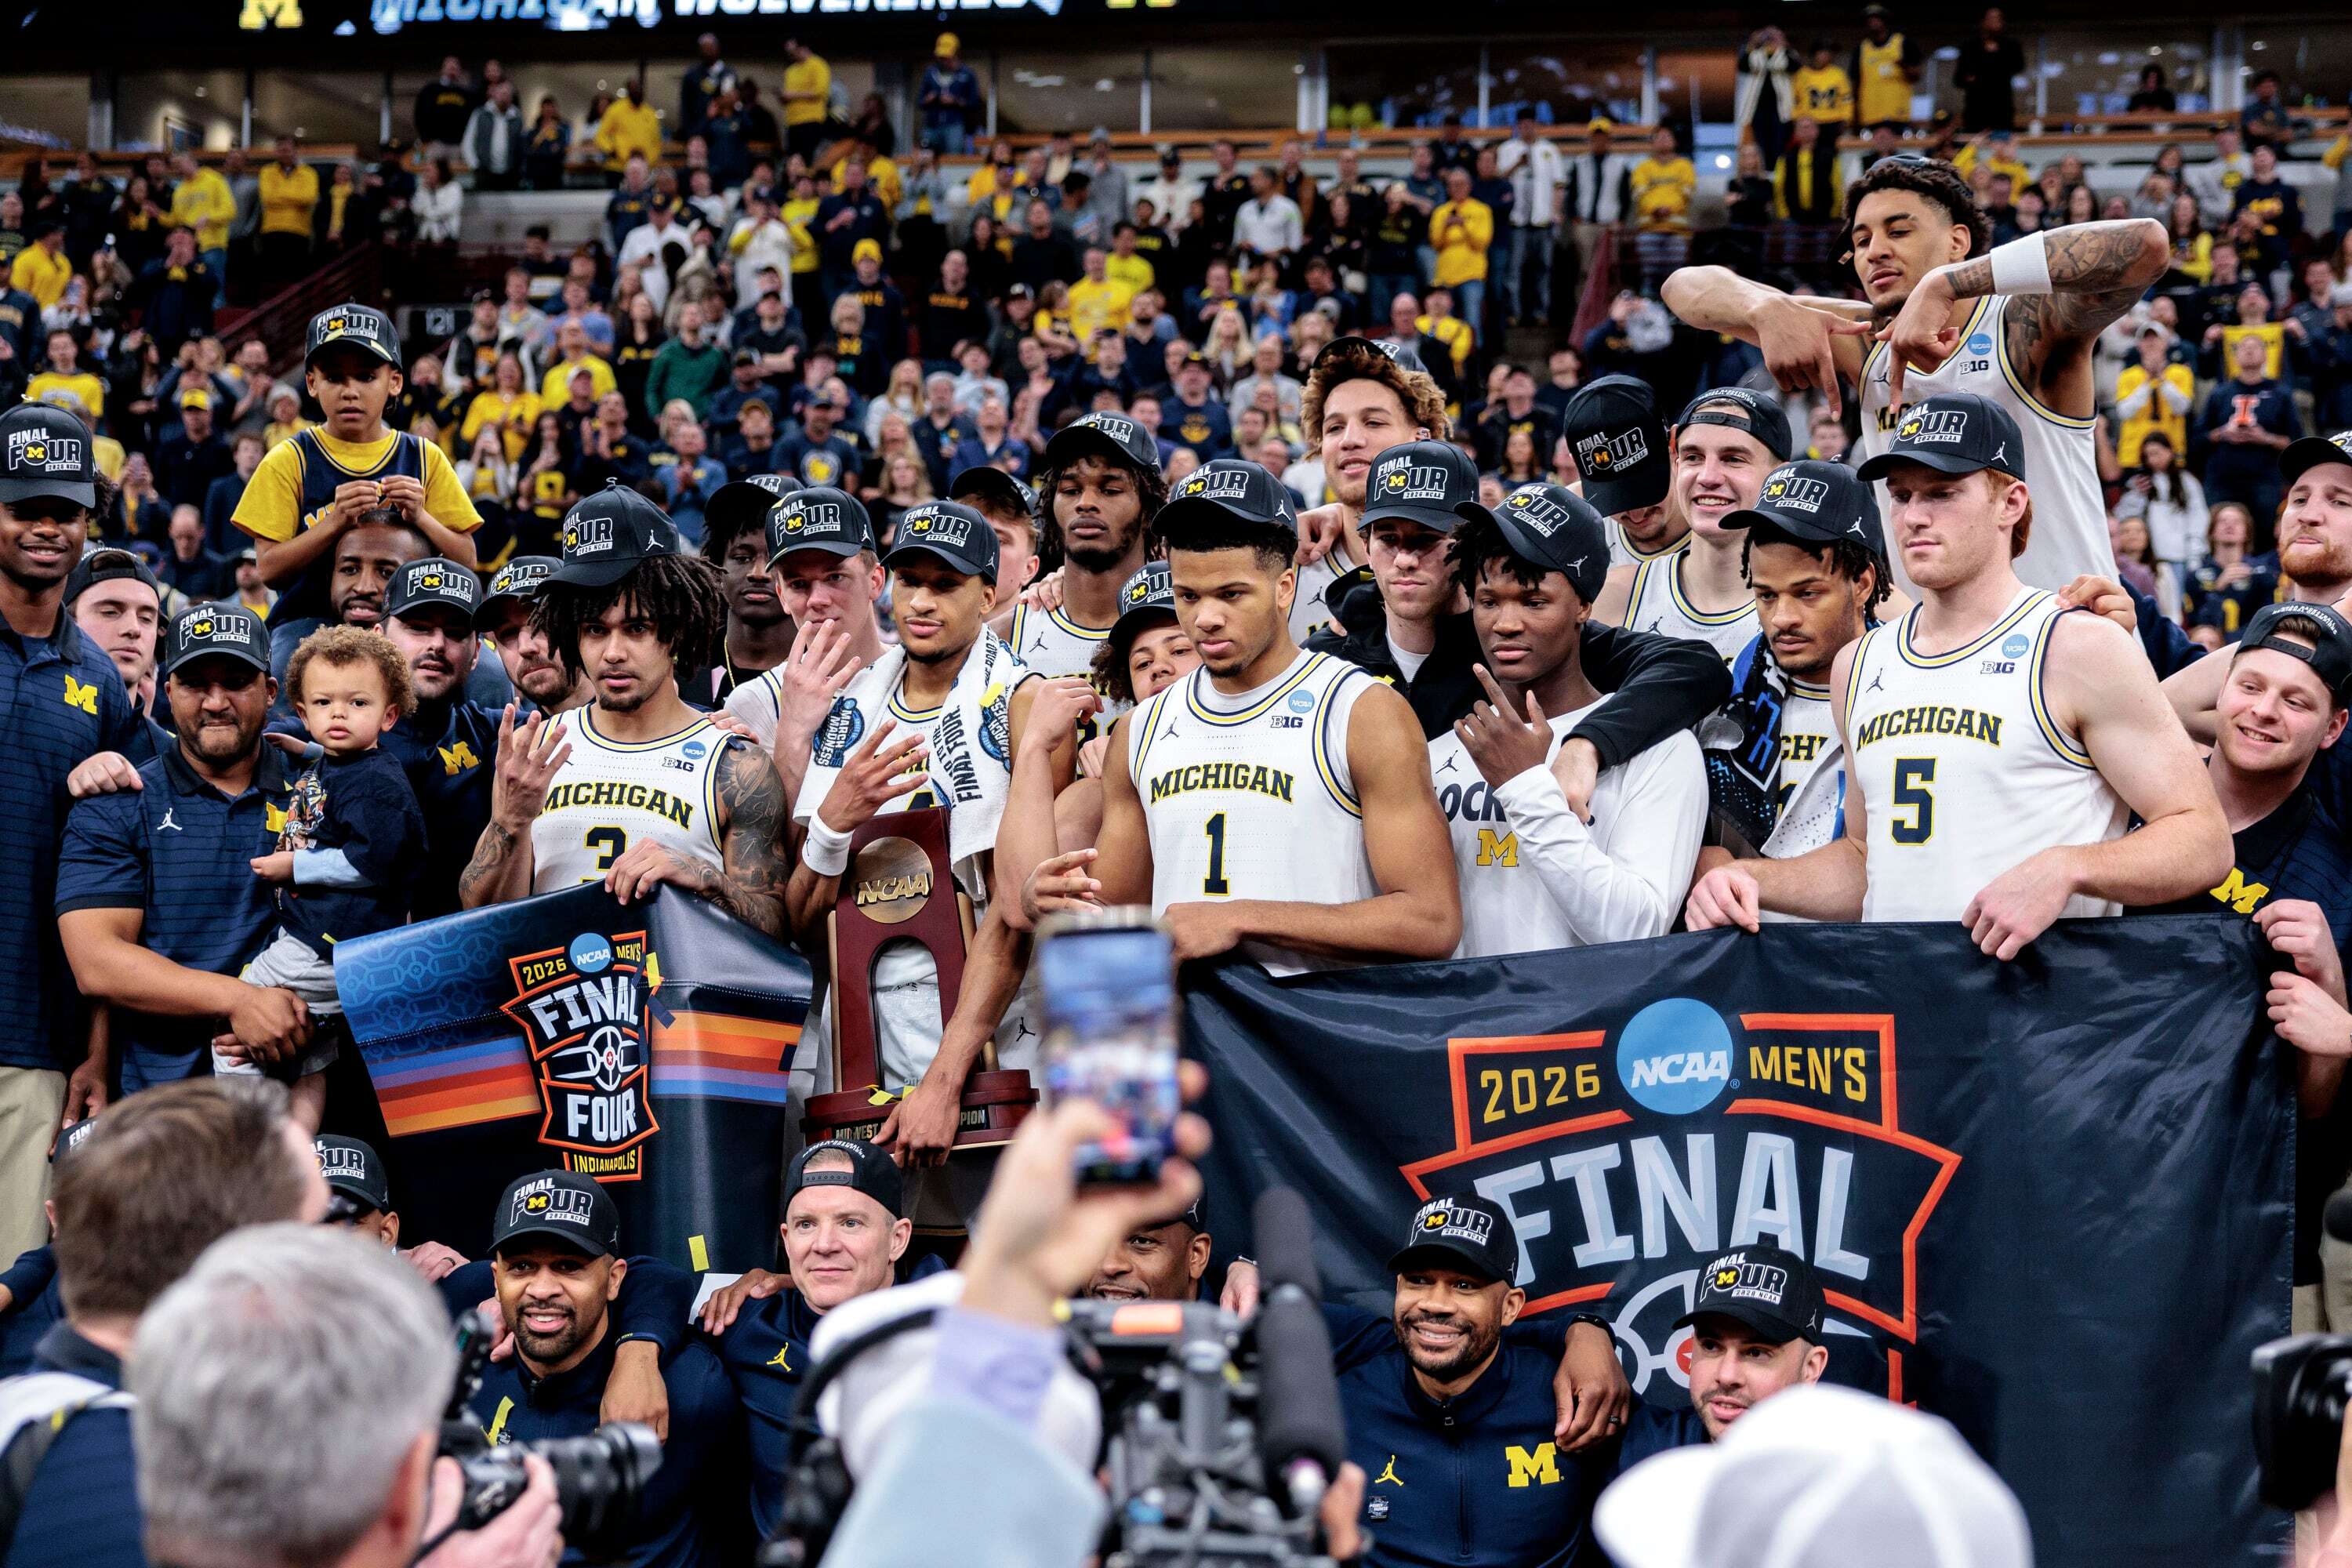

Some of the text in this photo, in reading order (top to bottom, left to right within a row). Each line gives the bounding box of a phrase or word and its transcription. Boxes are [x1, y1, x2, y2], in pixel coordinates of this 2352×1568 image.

[9, 428, 49, 446] FINAL
[1577, 432, 1609, 454] FINAL
[1377, 456, 1413, 477] FINAL
[775, 499, 805, 524] FINAL
[904, 506, 939, 524] FINAL
[408, 564, 445, 578] FINAL
[180, 608, 216, 630] FINAL
[64, 674, 98, 715] M
[818, 715, 841, 766] MADNESS
[835, 710, 853, 749] MARCH
[1856, 706, 2002, 753] MICHIGAN
[437, 740, 479, 776] M
[953, 750, 983, 803] FINAL
[1150, 762, 1294, 808] MICHIGAN
[1891, 756, 1938, 846] 5
[542, 782, 695, 831] MICHIGAN
[583, 825, 628, 884] 3
[1203, 811, 1230, 896] 1
[1476, 828, 1519, 867] M
[857, 873, 931, 906] NCAA
[2209, 866, 2270, 914] M
[522, 942, 641, 985] 2026 NCAA MEN'S
[528, 976, 639, 1040] FINAL
[1480, 1045, 1867, 1124] 2026 NCAA MEN'S
[567, 1087, 637, 1142] FOUR
[574, 1149, 636, 1173] INDIANAPOLIS
[514, 1178, 555, 1201] FINAL
[1415, 1198, 1454, 1221] FINAL
[1472, 1132, 1871, 1287] FINAL
[1706, 1252, 1746, 1276] FINAL
[1505, 1442, 1560, 1487] M
